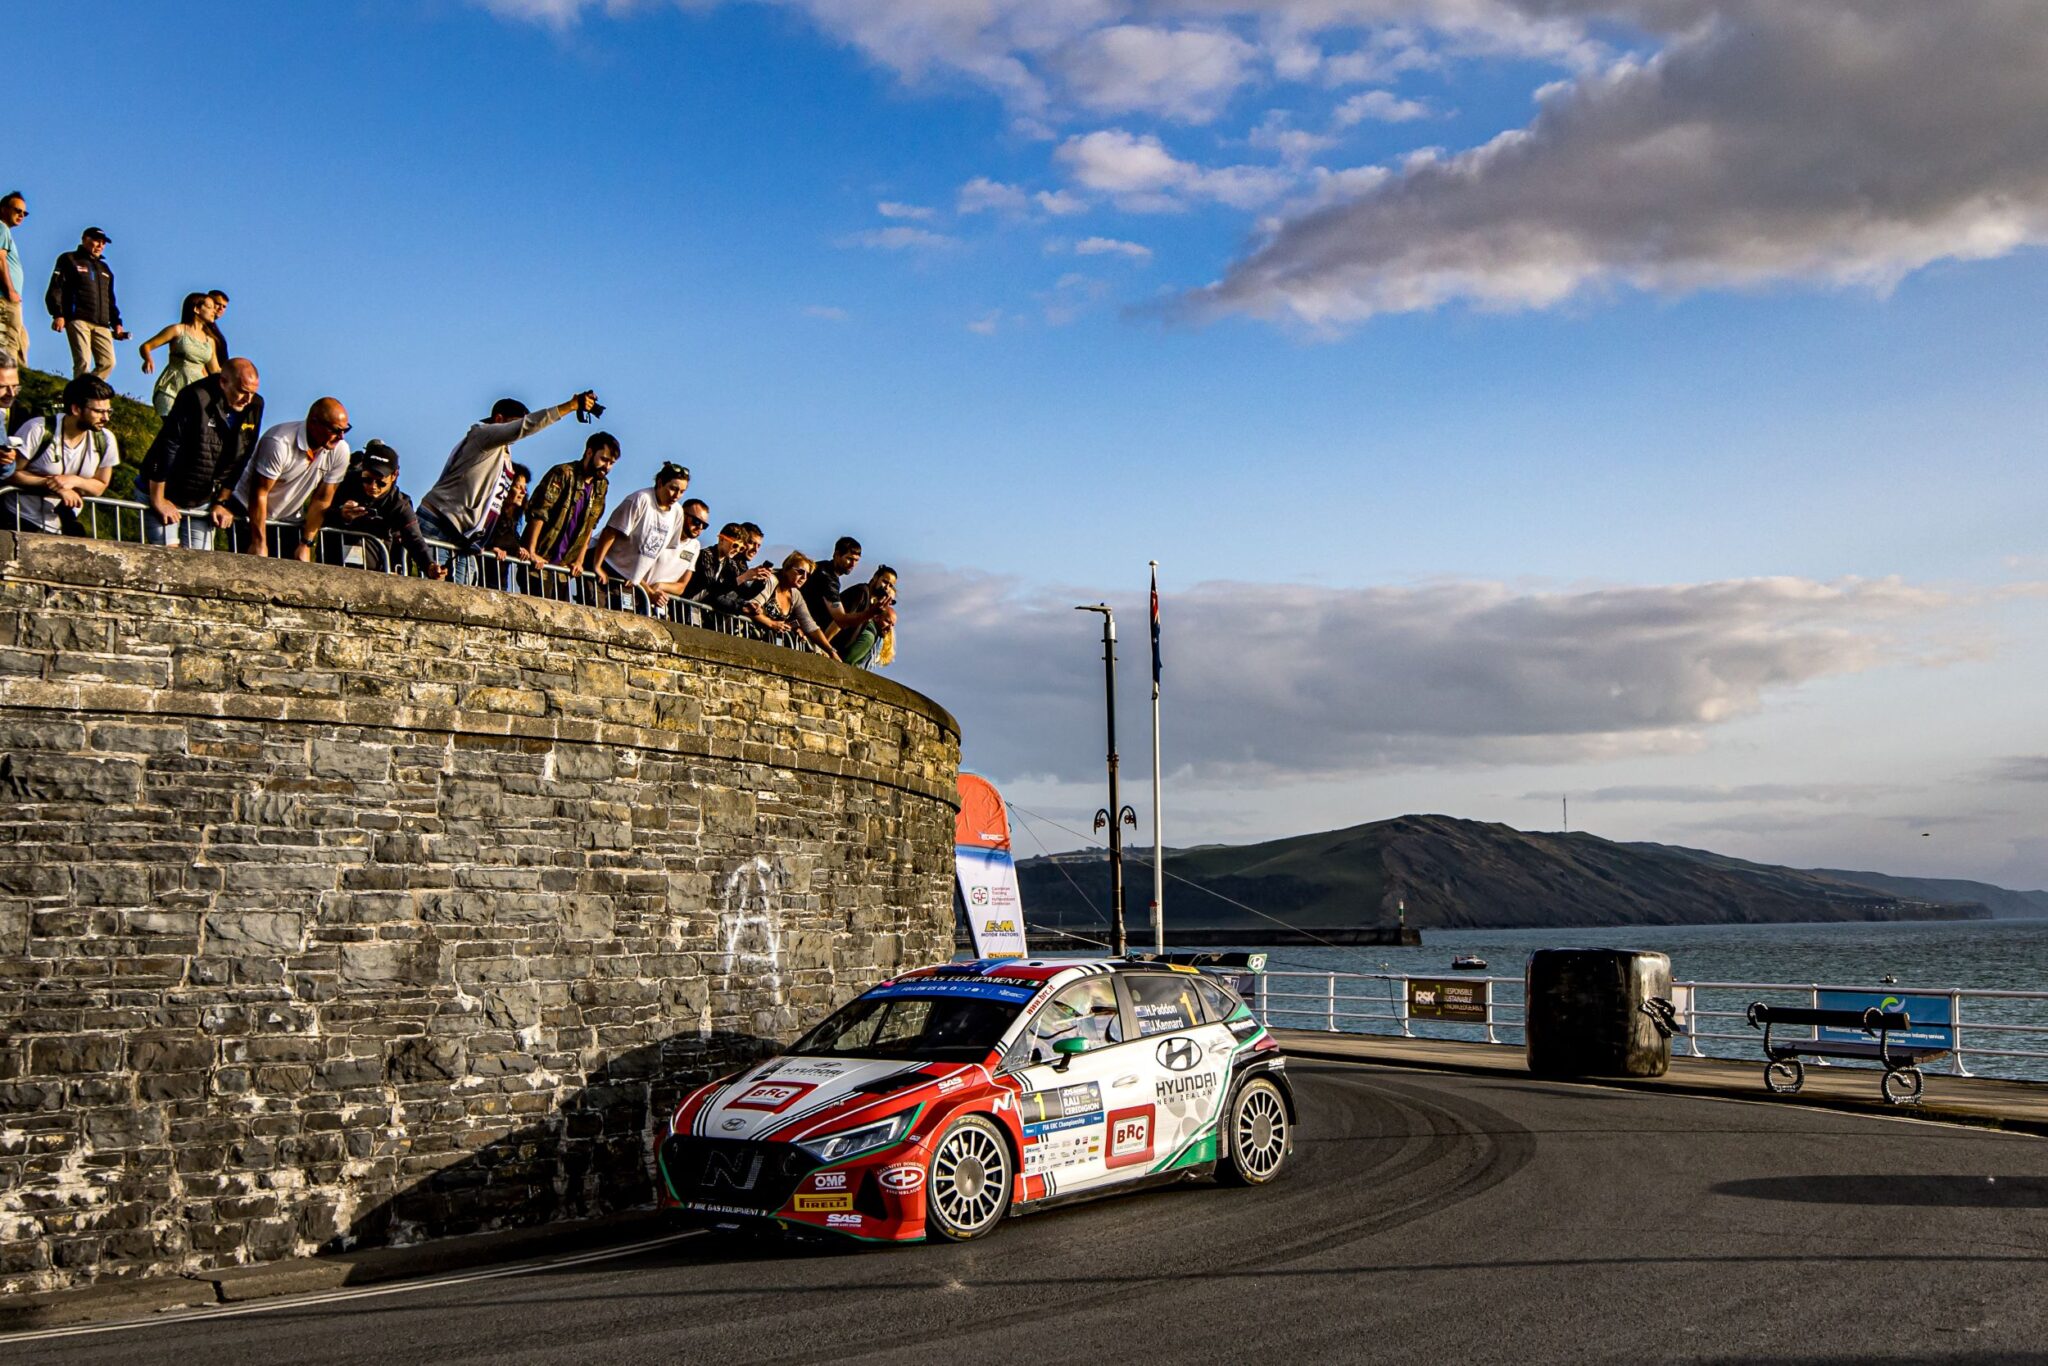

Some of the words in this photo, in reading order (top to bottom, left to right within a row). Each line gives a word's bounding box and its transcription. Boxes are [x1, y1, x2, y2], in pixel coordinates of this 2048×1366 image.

[984, 919, 1015, 932] E&M
[920, 975, 947, 983] GAS
[948, 975, 1026, 986] EQUIPMENT
[1415, 990, 1436, 1005] RSK
[1444, 987, 1473, 996] RESPONSIBLE
[1026, 984, 1056, 1016] www.brc.it
[1444, 995, 1473, 1004] SUSTAINABLE
[1145, 1003, 1178, 1016] H.Paddon
[1179, 992, 1198, 1025] 1
[1150, 1017, 1184, 1031] J.Kennard
[937, 1076, 963, 1090] SAS
[1156, 1072, 1217, 1098] HYUNDAI
[751, 1088, 790, 1099] BRC
[1157, 1097, 1175, 1106] NEW
[1180, 1088, 1216, 1102] ZEALAN
[1033, 1092, 1046, 1121] 1
[1063, 1096, 1080, 1108] RALI
[1064, 1102, 1100, 1115] CEREDIGION
[1058, 1118, 1086, 1129] Championship
[1117, 1123, 1144, 1144] BRC
[814, 1175, 846, 1187] OMP
[798, 1196, 848, 1209] PIRELLI
[707, 1204, 721, 1212] GAS
[721, 1205, 759, 1216] EQUIPMENT
[826, 1213, 863, 1224] SAS
